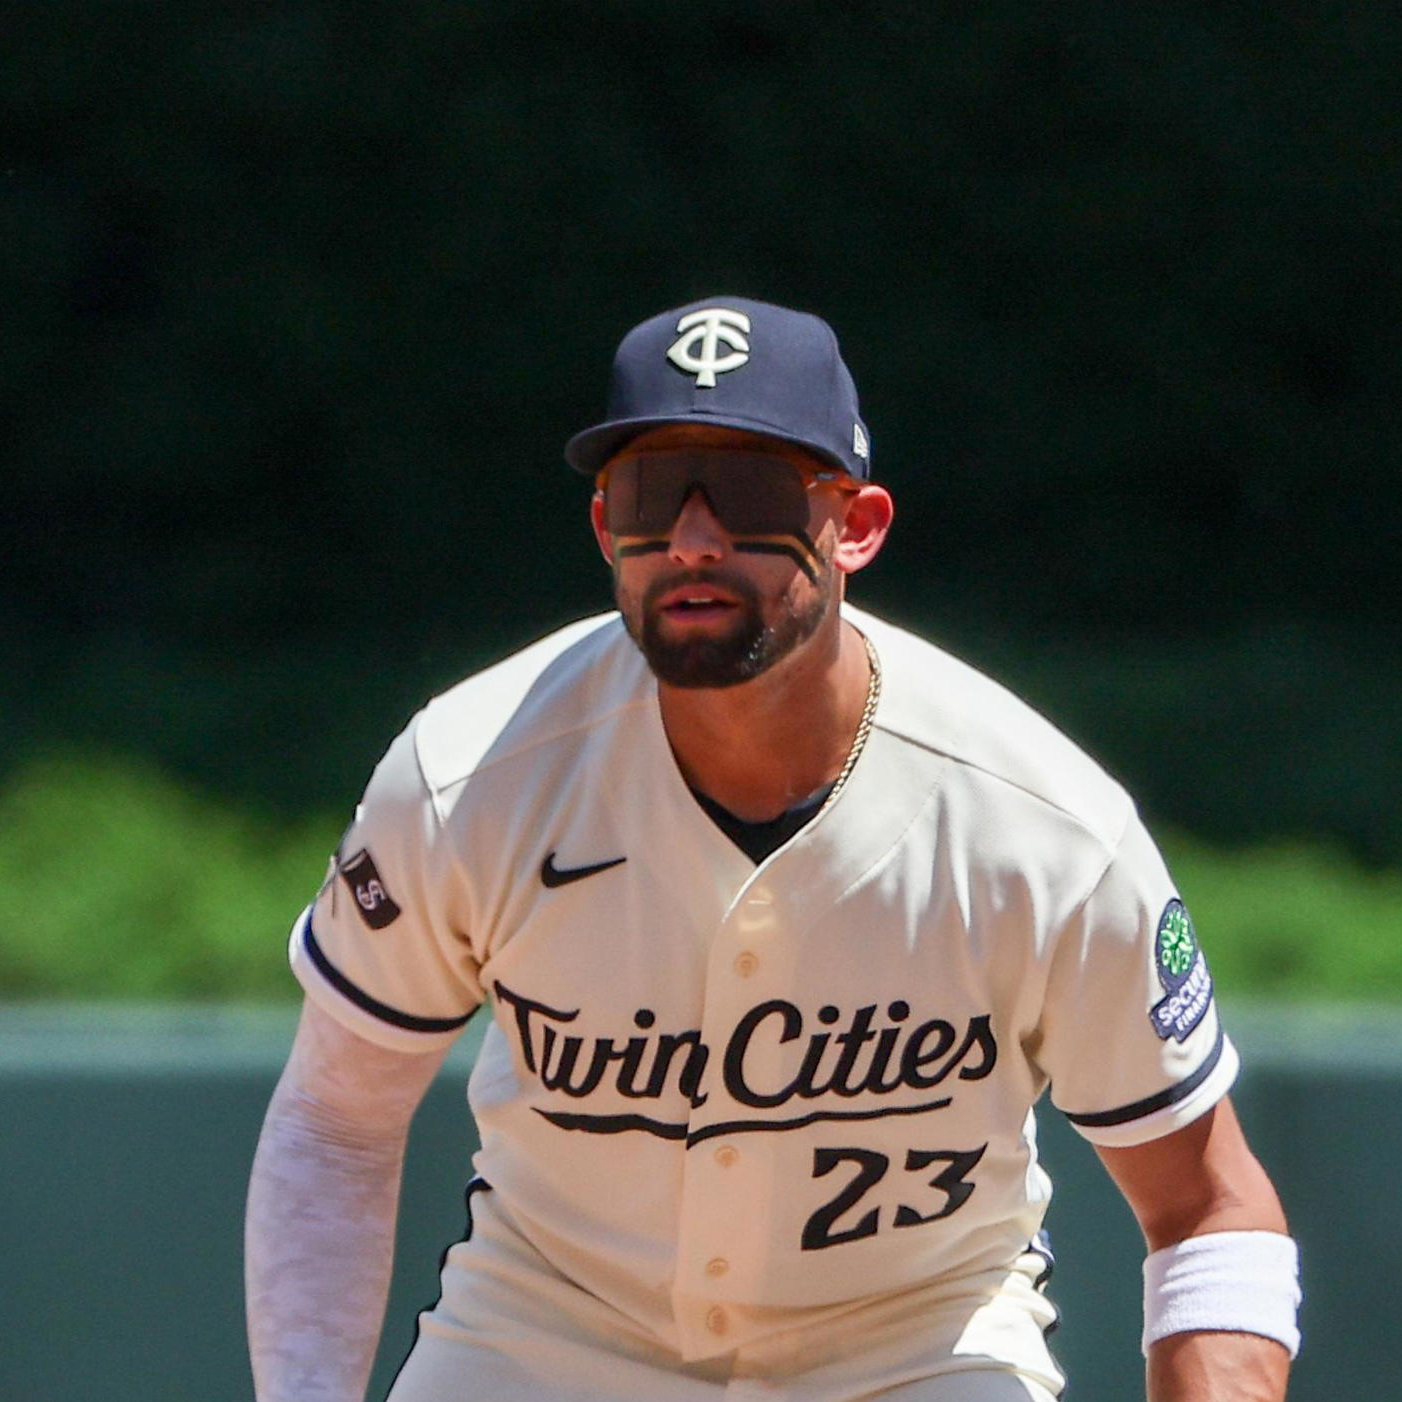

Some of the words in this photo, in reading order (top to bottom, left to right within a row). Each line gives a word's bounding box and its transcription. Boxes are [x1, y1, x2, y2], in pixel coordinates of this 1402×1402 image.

[494, 979, 709, 1109] Twin
[723, 999, 997, 1108] Cities
[801, 1142, 988, 1250] 23
